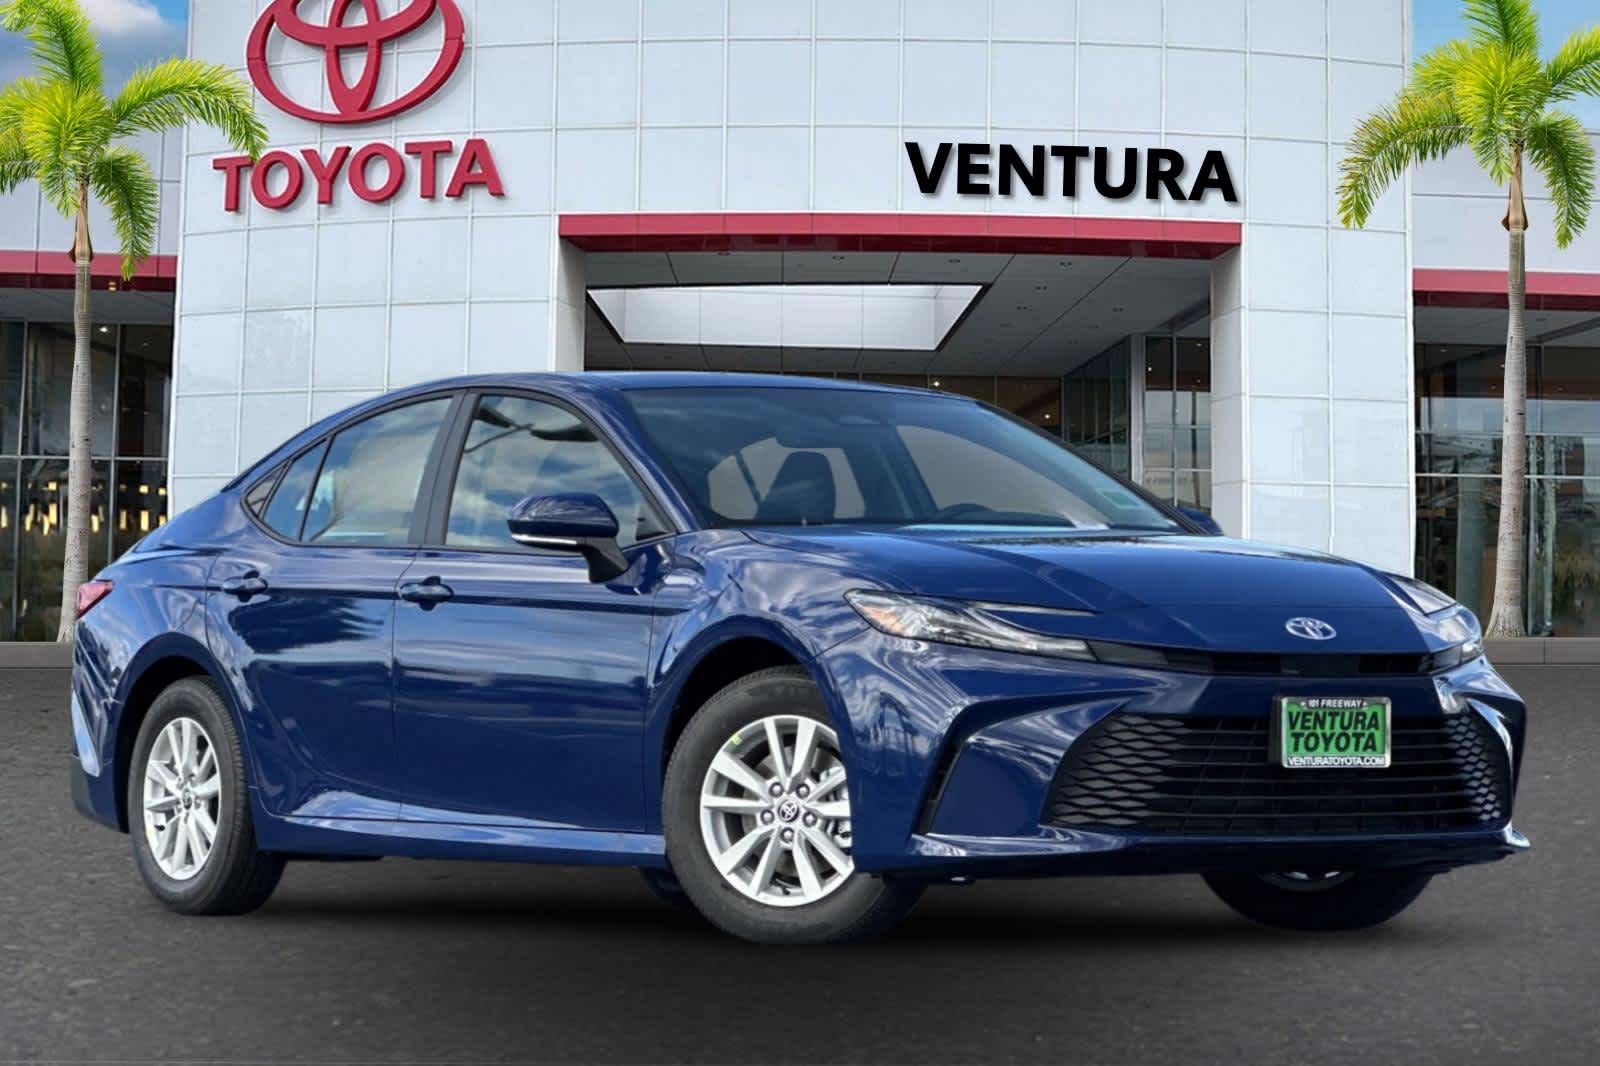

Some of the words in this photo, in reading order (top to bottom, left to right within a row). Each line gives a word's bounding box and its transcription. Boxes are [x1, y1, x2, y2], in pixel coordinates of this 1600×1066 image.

[212, 138, 505, 212] TOYOTA
[904, 141, 1242, 203] VENTURA
[1321, 699, 1361, 708] FREEWAY
[1288, 711, 1379, 730] VENTURA
[1291, 732, 1377, 752] TOYOTA
[1288, 756, 1385, 766] VENTURATOYOTA.COM
